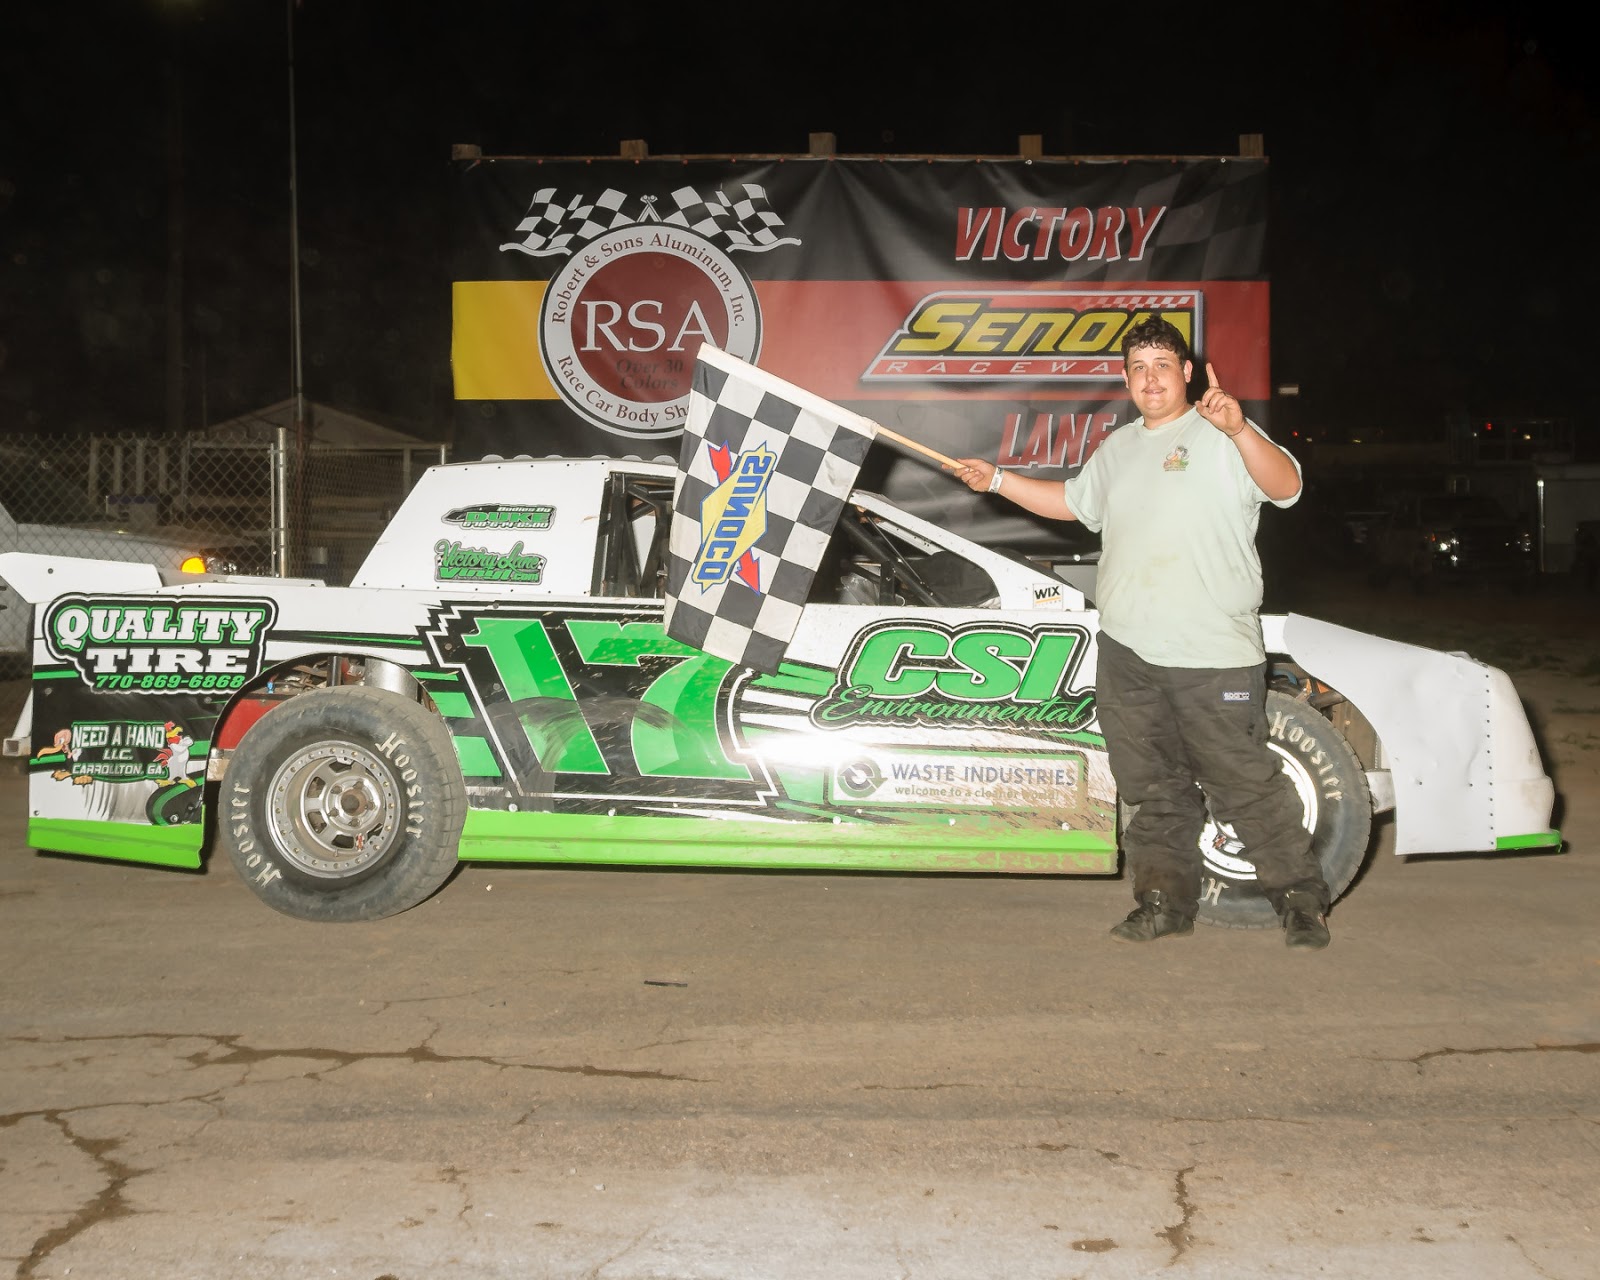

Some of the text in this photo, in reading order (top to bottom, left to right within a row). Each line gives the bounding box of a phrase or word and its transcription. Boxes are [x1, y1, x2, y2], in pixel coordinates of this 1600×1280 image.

[955, 206, 1167, 262] VICTORY
[552, 232, 746, 327] Robert & Sons Aluminum, Inc.
[580, 300, 725, 352] RSA
[616, 359, 684, 374] Over 30
[887, 361, 1110, 374] RACEWA
[558, 355, 586, 393] Race
[586, 389, 613, 413] Car
[616, 405, 660, 427] Body
[620, 374, 678, 389] Colors
[466, 512, 550, 523] DUKE
[435, 540, 539, 573] Victory Lane
[1034, 586, 1060, 599] WIX
[56, 607, 263, 649] QUALITY
[86, 648, 250, 673] TIRE
[850, 629, 1077, 700] CSI
[96, 674, 245, 688] 770-869-6868
[461, 618, 754, 781] 17
[821, 685, 1094, 724] Environmental
[72, 725, 165, 748] NEED A HAND
[891, 764, 1076, 786] WASTE INDUSTRIES
[895, 785, 947, 797] welcome
[949, 786, 961, 797] to
